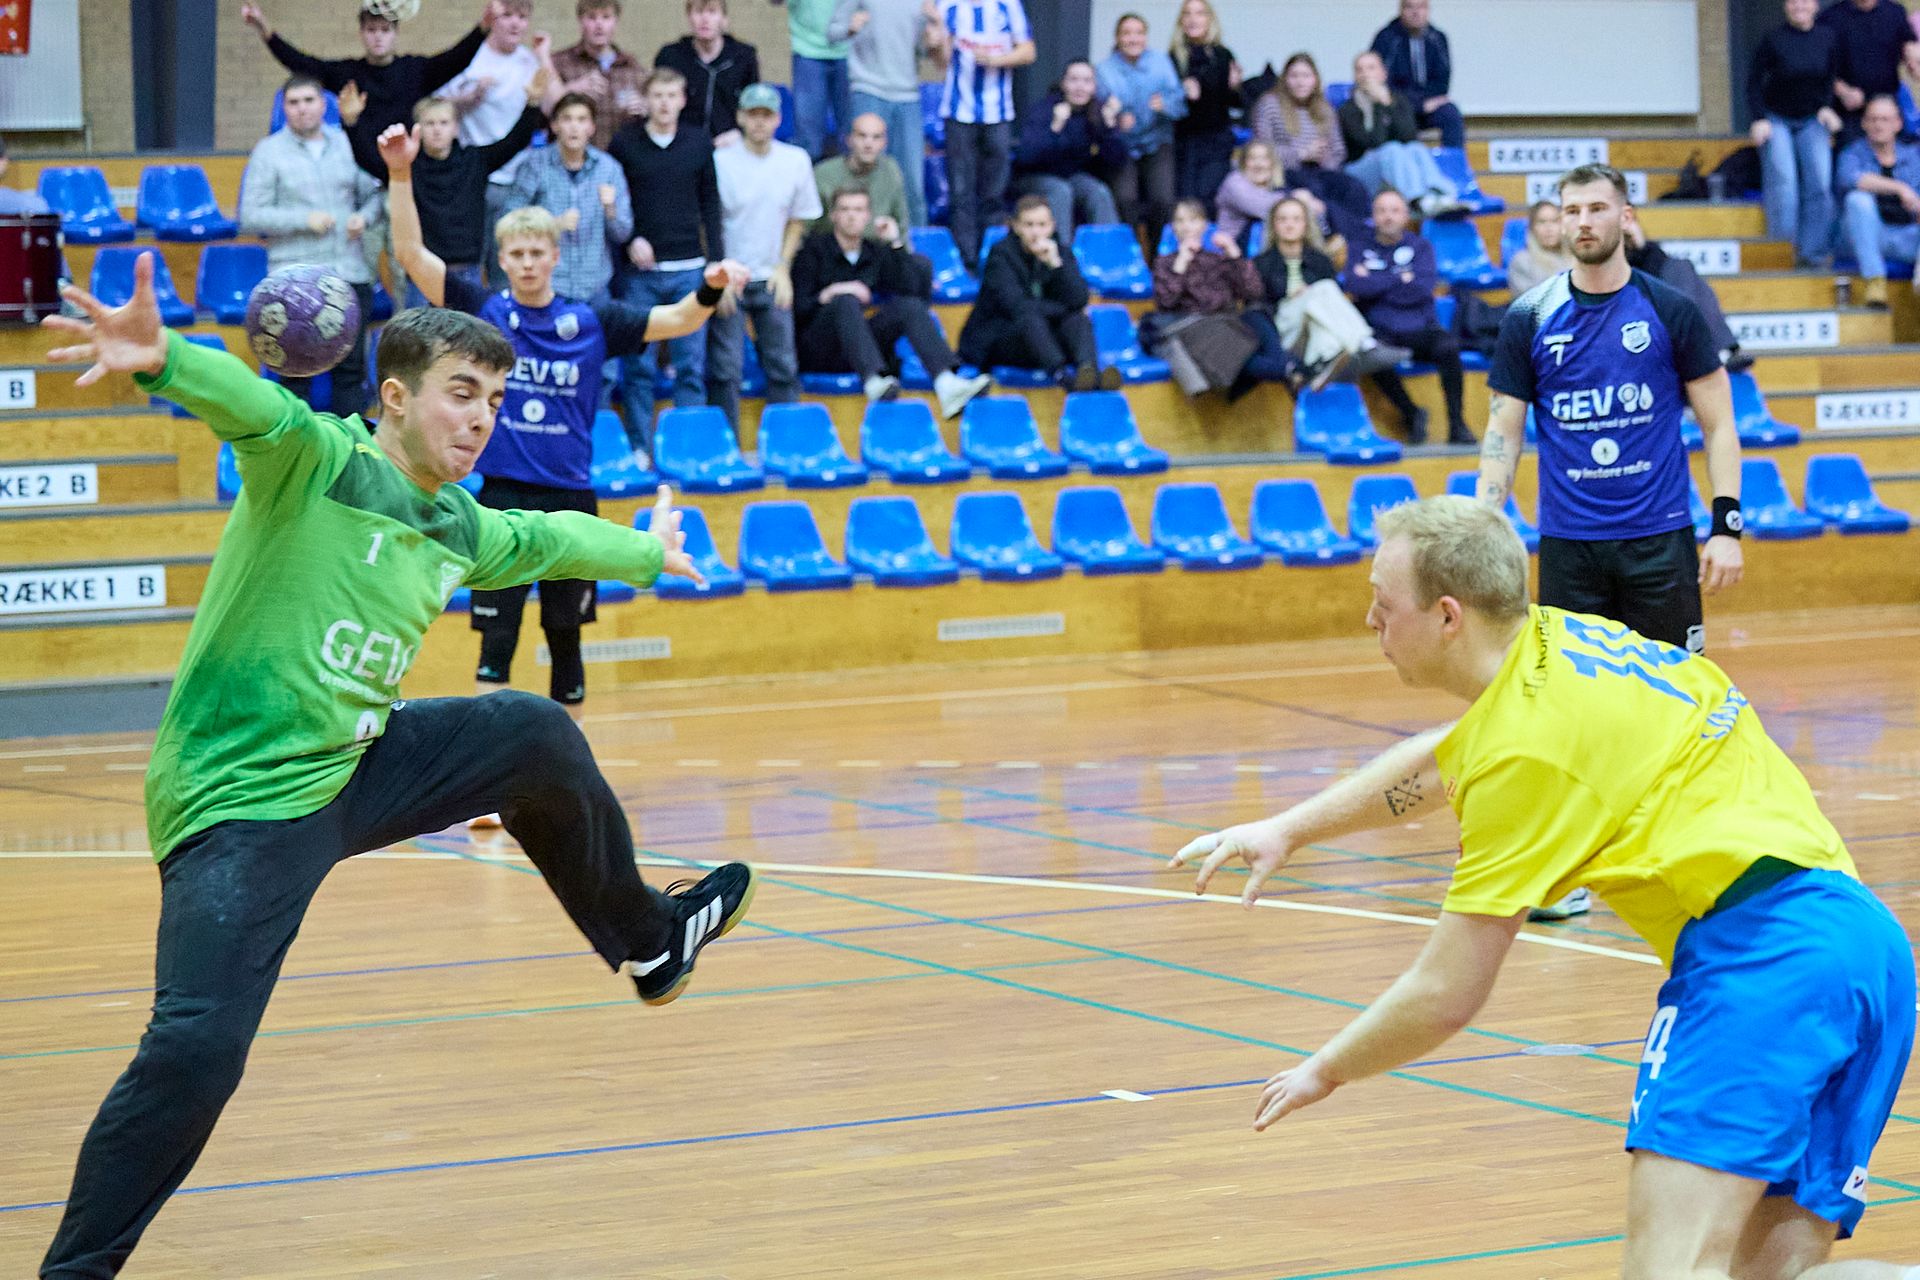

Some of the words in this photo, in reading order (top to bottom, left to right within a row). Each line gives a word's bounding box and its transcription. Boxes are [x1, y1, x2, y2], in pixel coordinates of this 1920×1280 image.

[9, 380, 25, 399] B
[1551, 386, 1615, 421] GEV
[71, 474, 87, 496] B
[361, 532, 384, 567] 1
[0, 578, 96, 604] RÆKKE
[138, 576, 154, 597] B
[320, 620, 414, 687] GEV
